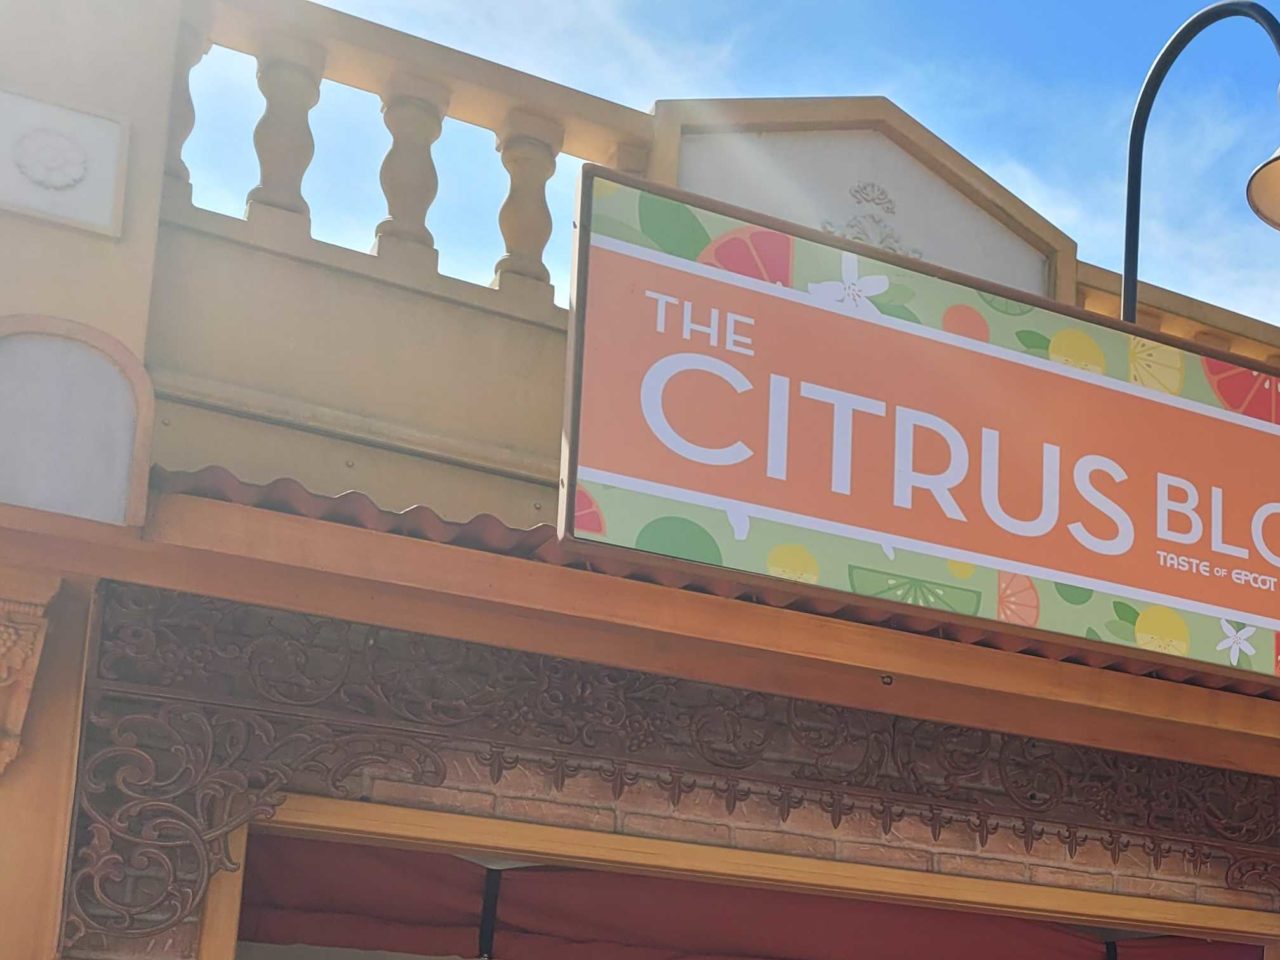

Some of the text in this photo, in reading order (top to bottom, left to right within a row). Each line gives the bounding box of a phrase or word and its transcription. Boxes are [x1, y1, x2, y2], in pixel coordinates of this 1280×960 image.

[645, 290, 755, 356] THE
[640, 352, 1135, 556] CITRUS
[1156, 550, 1210, 577] TASTE
[1214, 566, 1228, 577] OF
[1231, 569, 1278, 592] EPCOT
